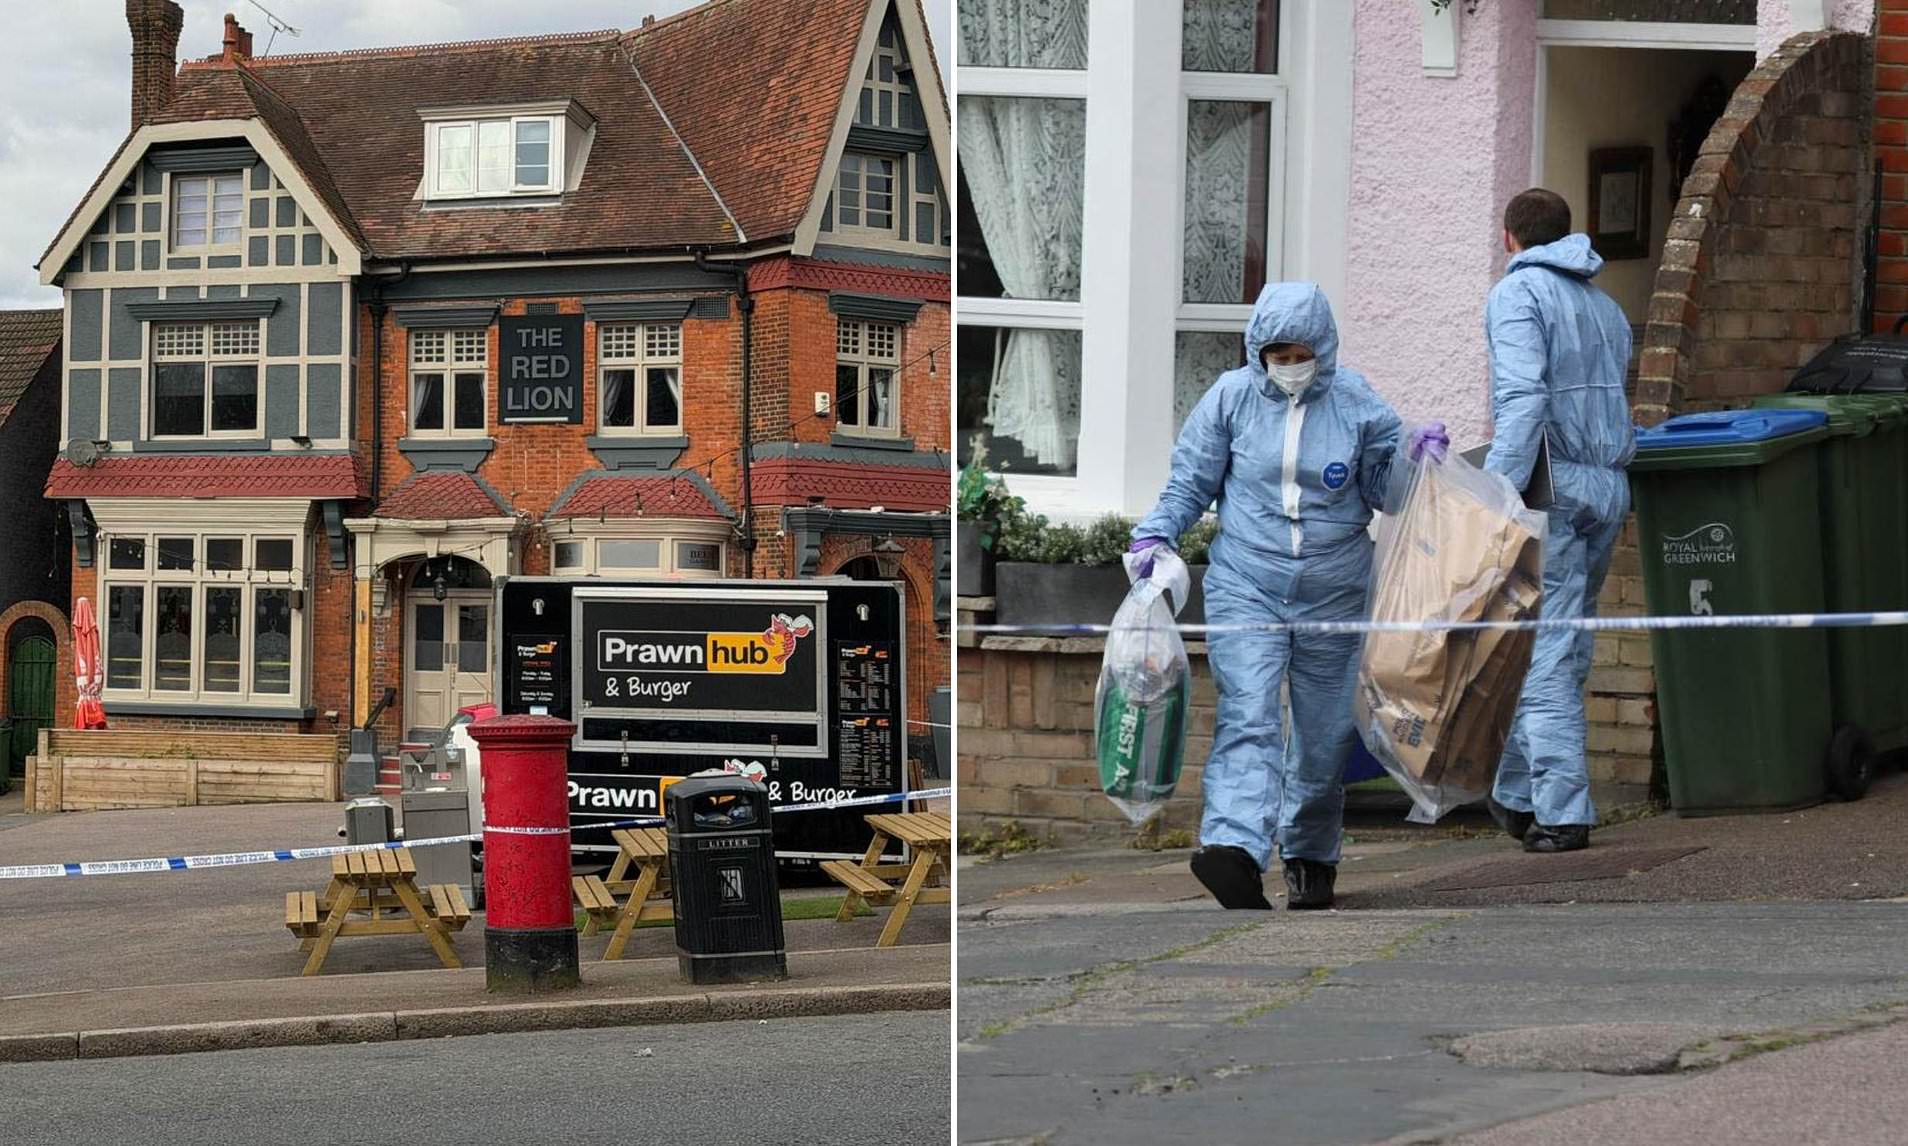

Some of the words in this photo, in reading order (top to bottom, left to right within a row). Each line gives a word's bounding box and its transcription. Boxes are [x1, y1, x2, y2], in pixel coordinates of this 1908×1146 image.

[516, 327, 562, 347] THE
[511, 355, 570, 379] RED
[507, 386, 573, 410] LION
[1663, 542, 1698, 553] ROYAL
[1663, 552, 1736, 564] GREENWICH
[605, 637, 704, 664] Prawn
[711, 640, 769, 665] hub
[605, 677, 620, 697] &
[627, 676, 692, 702] Burger
[1117, 703, 1139, 759] FIRST
[567, 780, 657, 808] Prawn
[768, 780, 782, 801] &
[790, 780, 857, 809] Burger
[708, 838, 749, 848] LITTER
